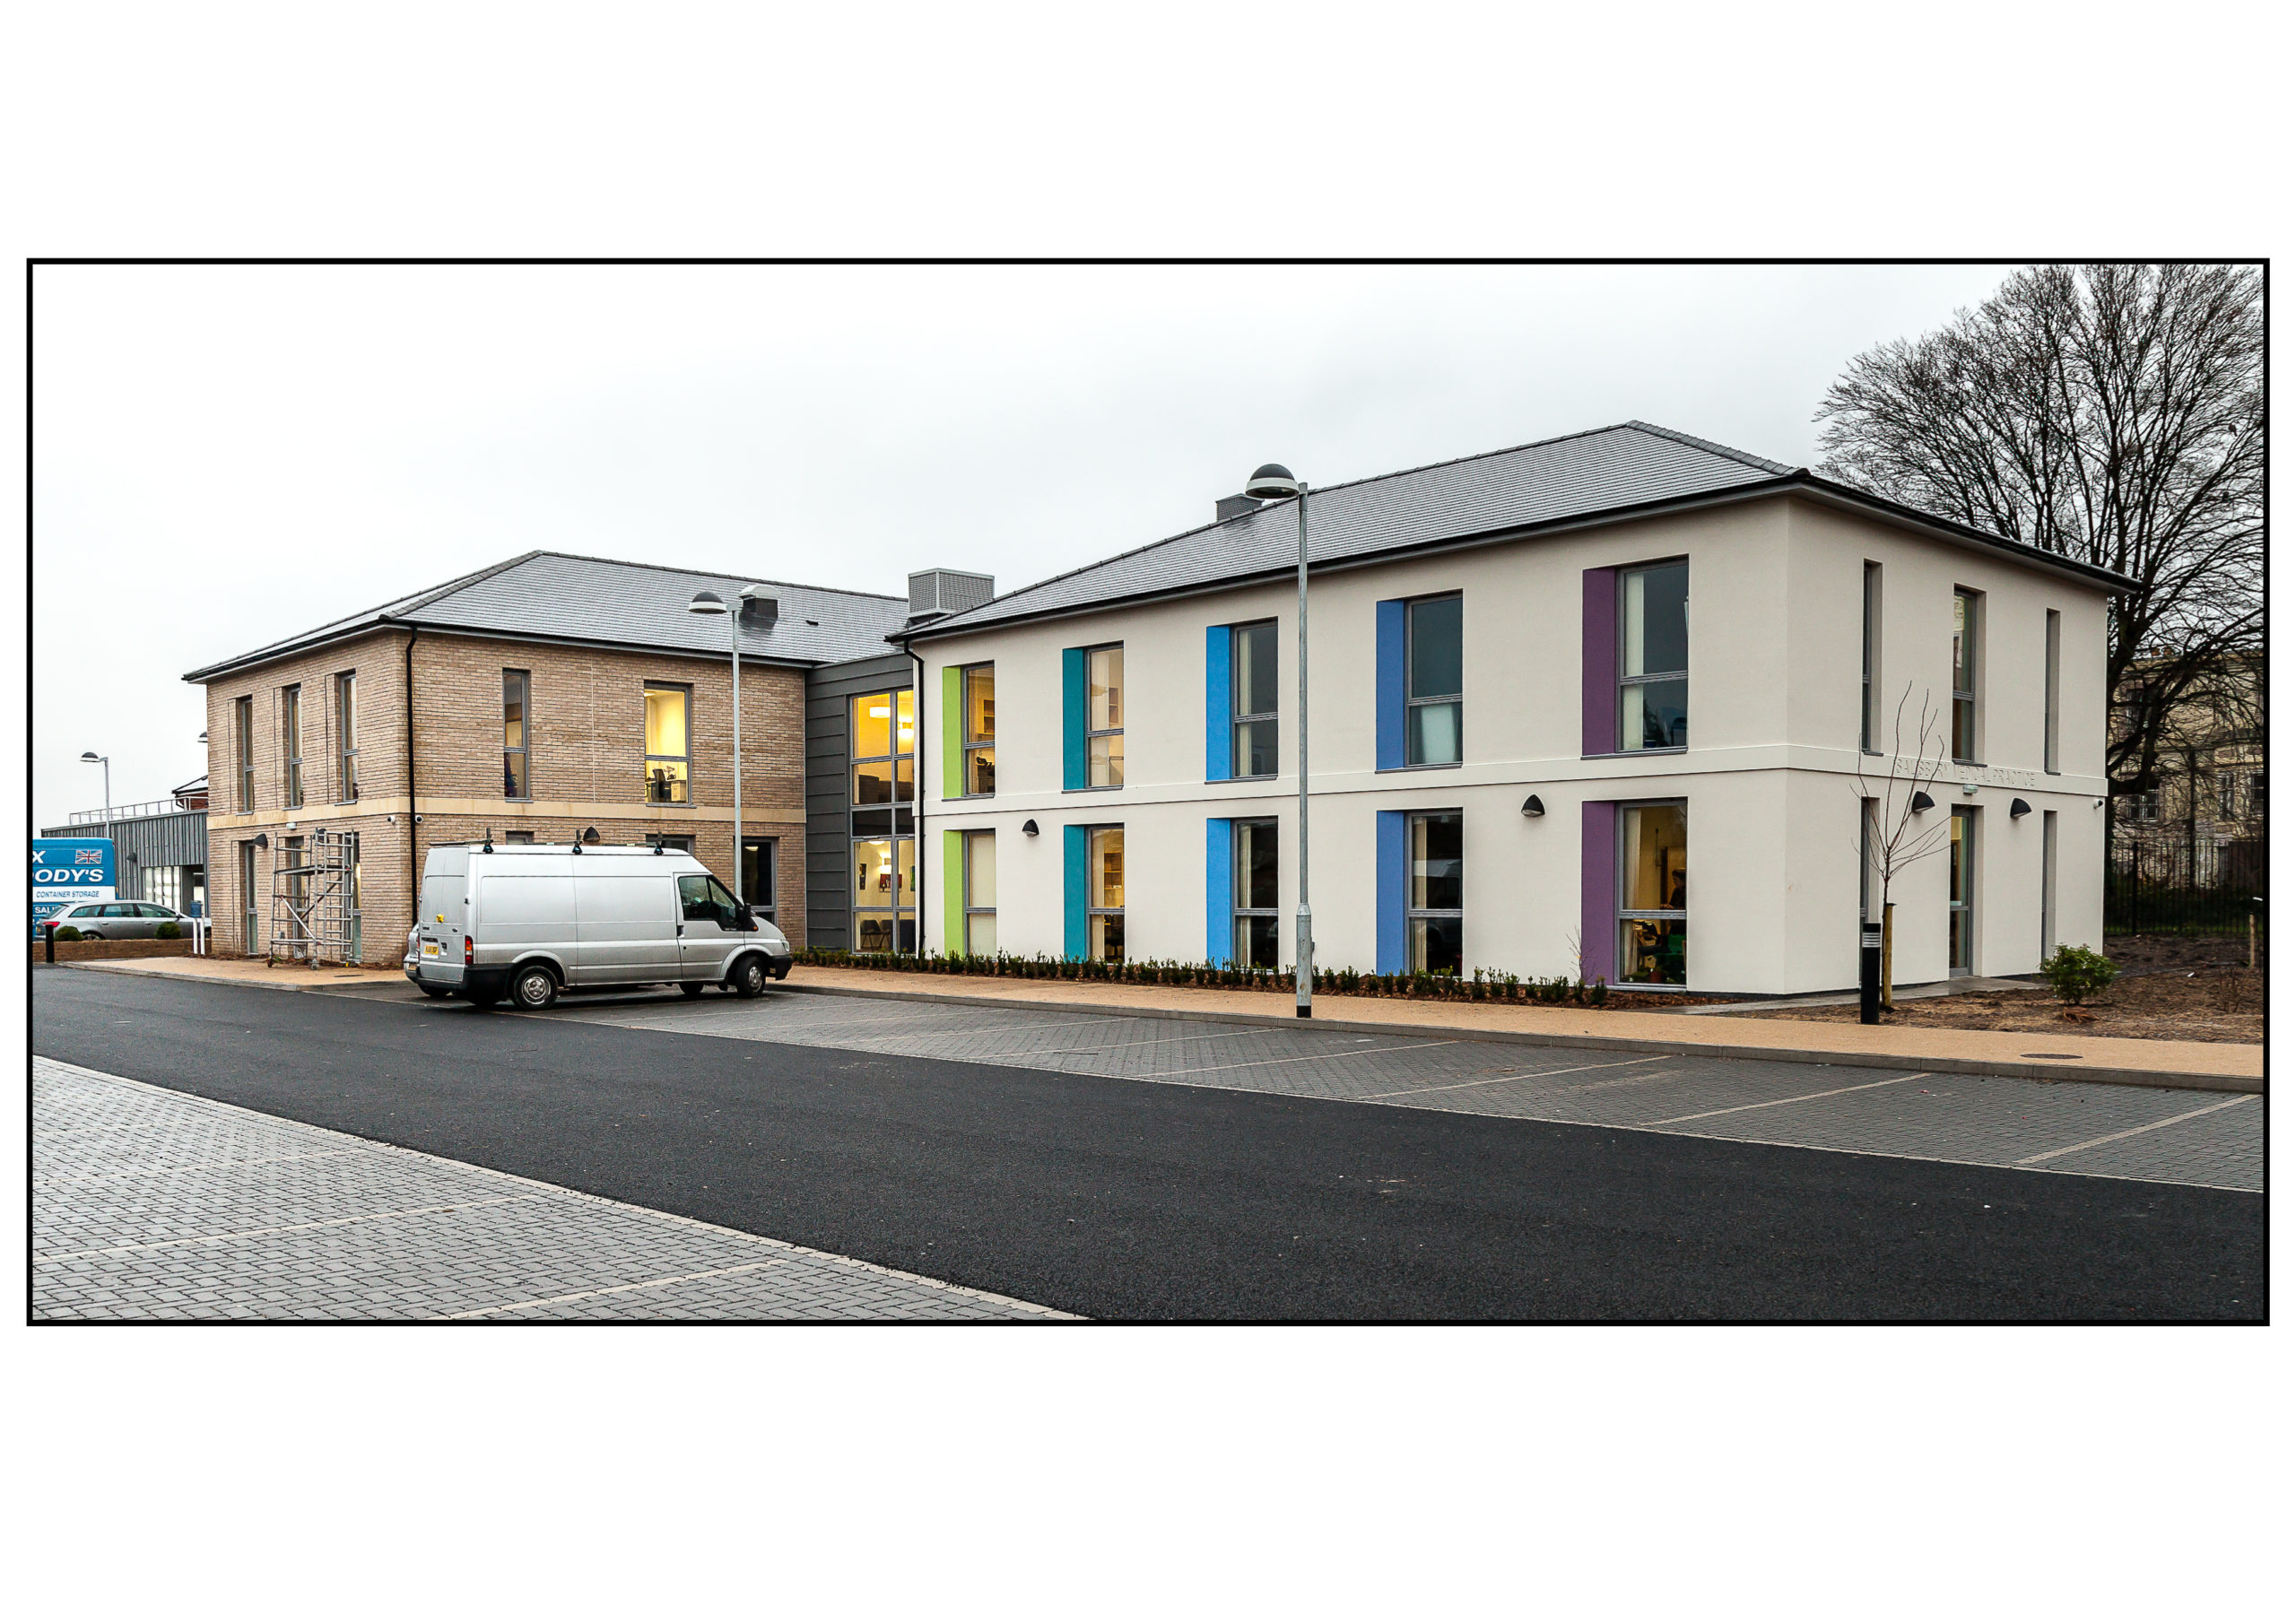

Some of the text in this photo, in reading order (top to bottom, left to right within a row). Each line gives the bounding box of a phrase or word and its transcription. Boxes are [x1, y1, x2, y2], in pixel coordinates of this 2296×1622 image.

[1896, 759, 1950, 778] SALSBURY
[1993, 768, 2036, 786] PRACTICE
[32, 868, 104, 882] ODY'S
[36, 890, 100, 898] CONTAINER STORAGE
